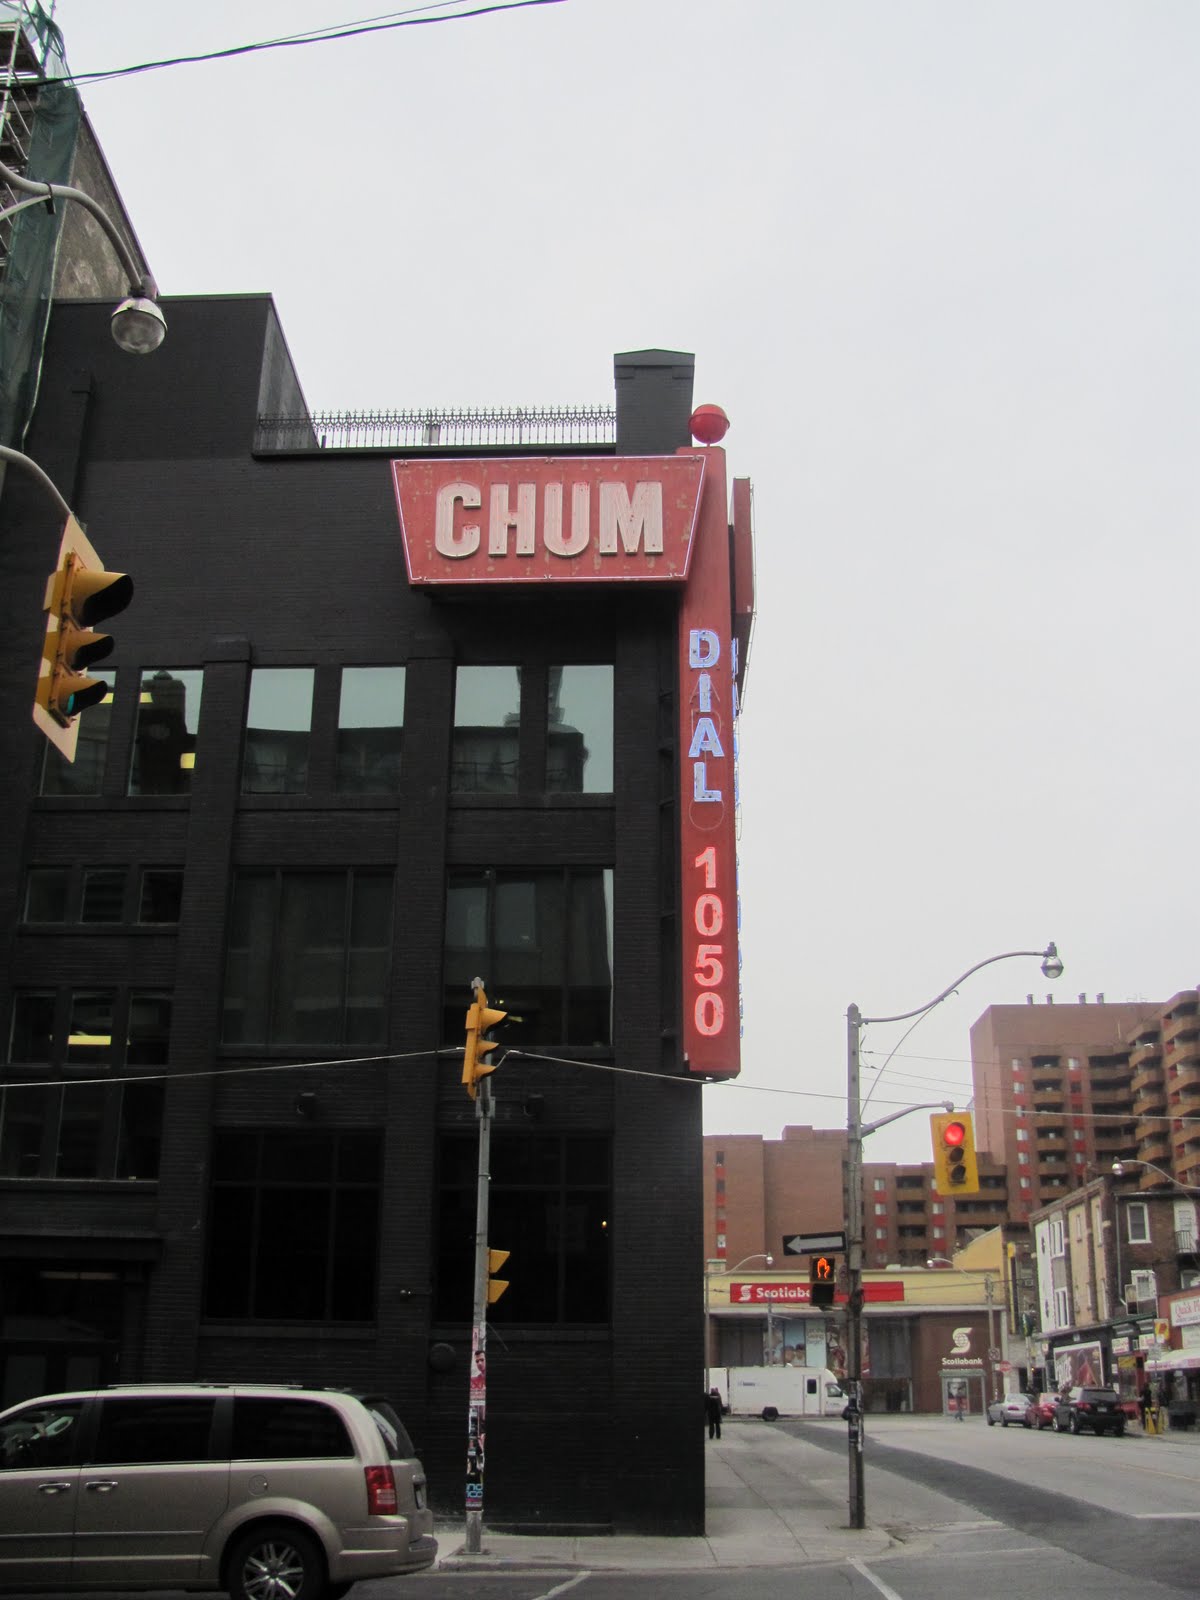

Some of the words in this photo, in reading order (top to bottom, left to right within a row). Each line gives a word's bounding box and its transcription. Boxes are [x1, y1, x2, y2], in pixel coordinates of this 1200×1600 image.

[435, 481, 664, 558] CHUM
[688, 629, 725, 802] DIAL
[694, 846, 724, 1036] 1050
[941, 1357, 983, 1365] Scotiabank
